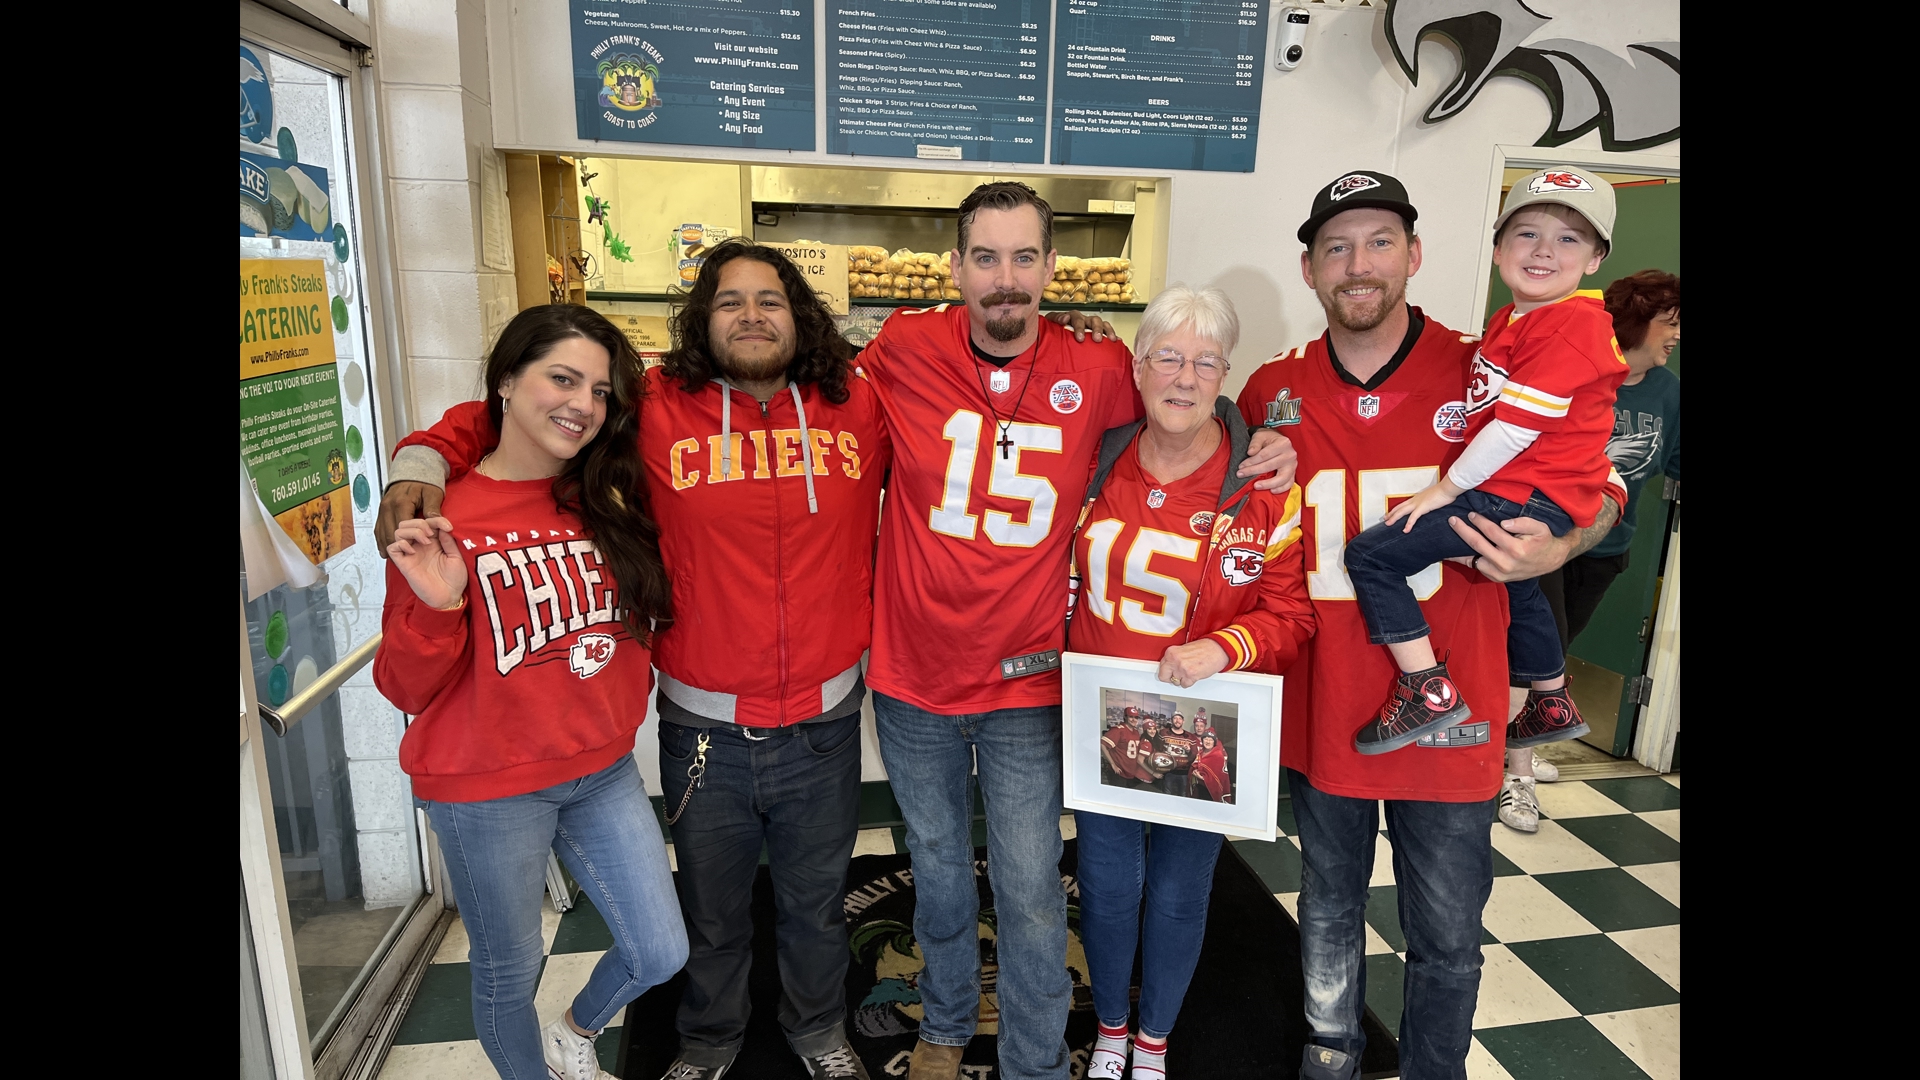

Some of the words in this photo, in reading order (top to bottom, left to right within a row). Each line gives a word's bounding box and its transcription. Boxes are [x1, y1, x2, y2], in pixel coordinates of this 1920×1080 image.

[584, 10, 620, 18] Vegetarian
[584, 19, 610, 27] Cheese,
[611, 20, 649, 29] Mushrooms,
[650, 23, 672, 31] Sweet,
[590, 39, 610, 60] PHILLY
[610, 34, 641, 46] FRANK'S
[640, 40, 665, 64] STEAKS
[714, 42, 732, 51] Visit
[748, 46, 778, 54] website
[694, 57, 799, 70] www.PhillyFranks.com
[875, 64, 898, 72] Dipping
[710, 80, 746, 93] Catering
[748, 83, 785, 94] Services
[724, 95, 740, 107] Any
[742, 96, 766, 107] Event
[603, 110, 625, 128] COAST
[627, 120, 635, 129] TO
[637, 111, 658, 128] COAST
[724, 109, 740, 121] Any
[743, 110, 760, 120] Size
[725, 123, 741, 134] Any
[743, 124, 763, 134] Food
[1543, 173, 1581, 188] KC
[808, 265, 826, 275] ICE
[252, 275, 289, 295] Frank's
[290, 273, 323, 293] Steaks
[240, 304, 322, 344] ATERING
[250, 347, 310, 364] www.PhillyFranks.com
[249, 384, 262, 397] THE
[262, 381, 273, 394] YO!
[273, 380, 283, 392] TO
[283, 376, 300, 389] YOUR
[300, 373, 314, 386] NEXT
[315, 369, 335, 383] EVENT!
[271, 409, 286, 420] Steaks
[286, 407, 293, 415] do
[670, 428, 861, 491] CHIEFS
[271, 472, 321, 503] 760.591.0145
[929, 409, 1064, 548] 15
[462, 530, 575, 550] KANSAS
[1233, 555, 1264, 577] KC
[1084, 518, 1202, 638] 15
[475, 540, 630, 678] CHIE
[585, 639, 610, 663] KC
[1029, 656, 1045, 665] XL
[842, 876, 898, 915] HILLY
